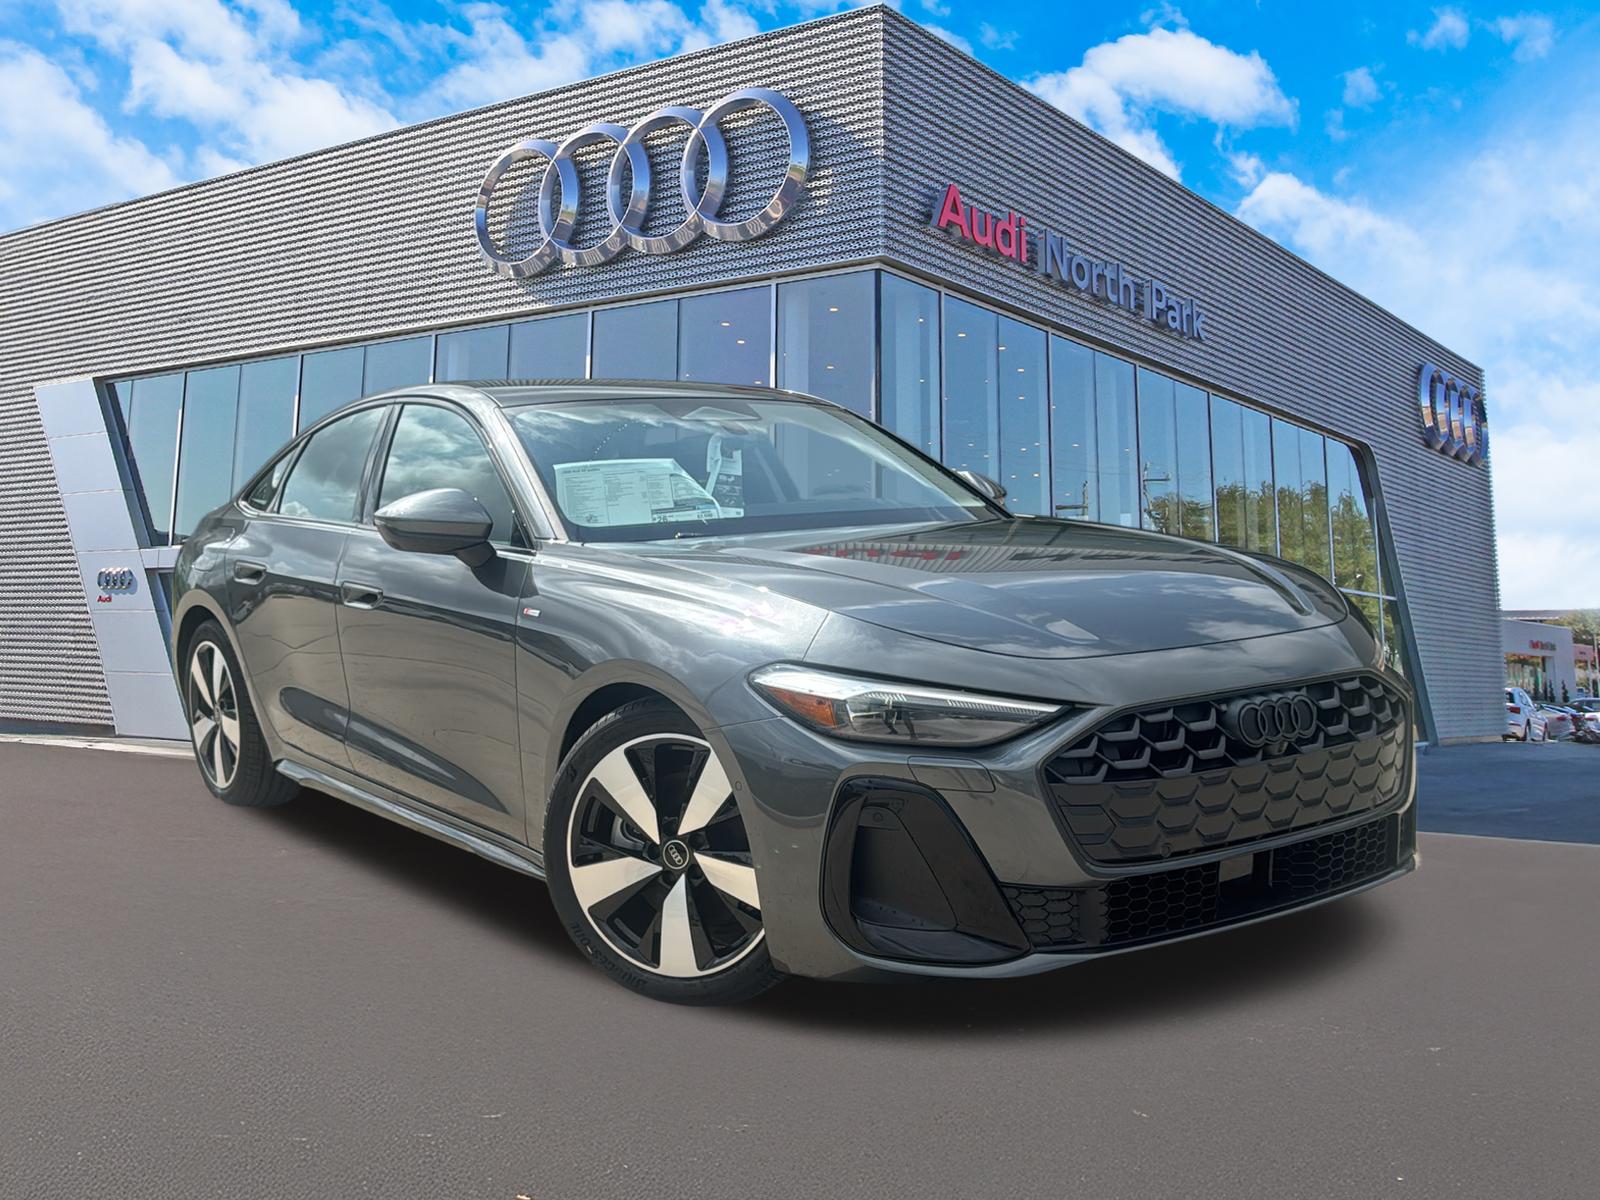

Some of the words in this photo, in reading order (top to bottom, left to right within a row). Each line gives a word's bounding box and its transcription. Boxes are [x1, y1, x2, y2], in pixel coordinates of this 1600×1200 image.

[931, 183, 1028, 264] Audi
[1038, 229, 1137, 313] North
[1143, 279, 1207, 341] Park
